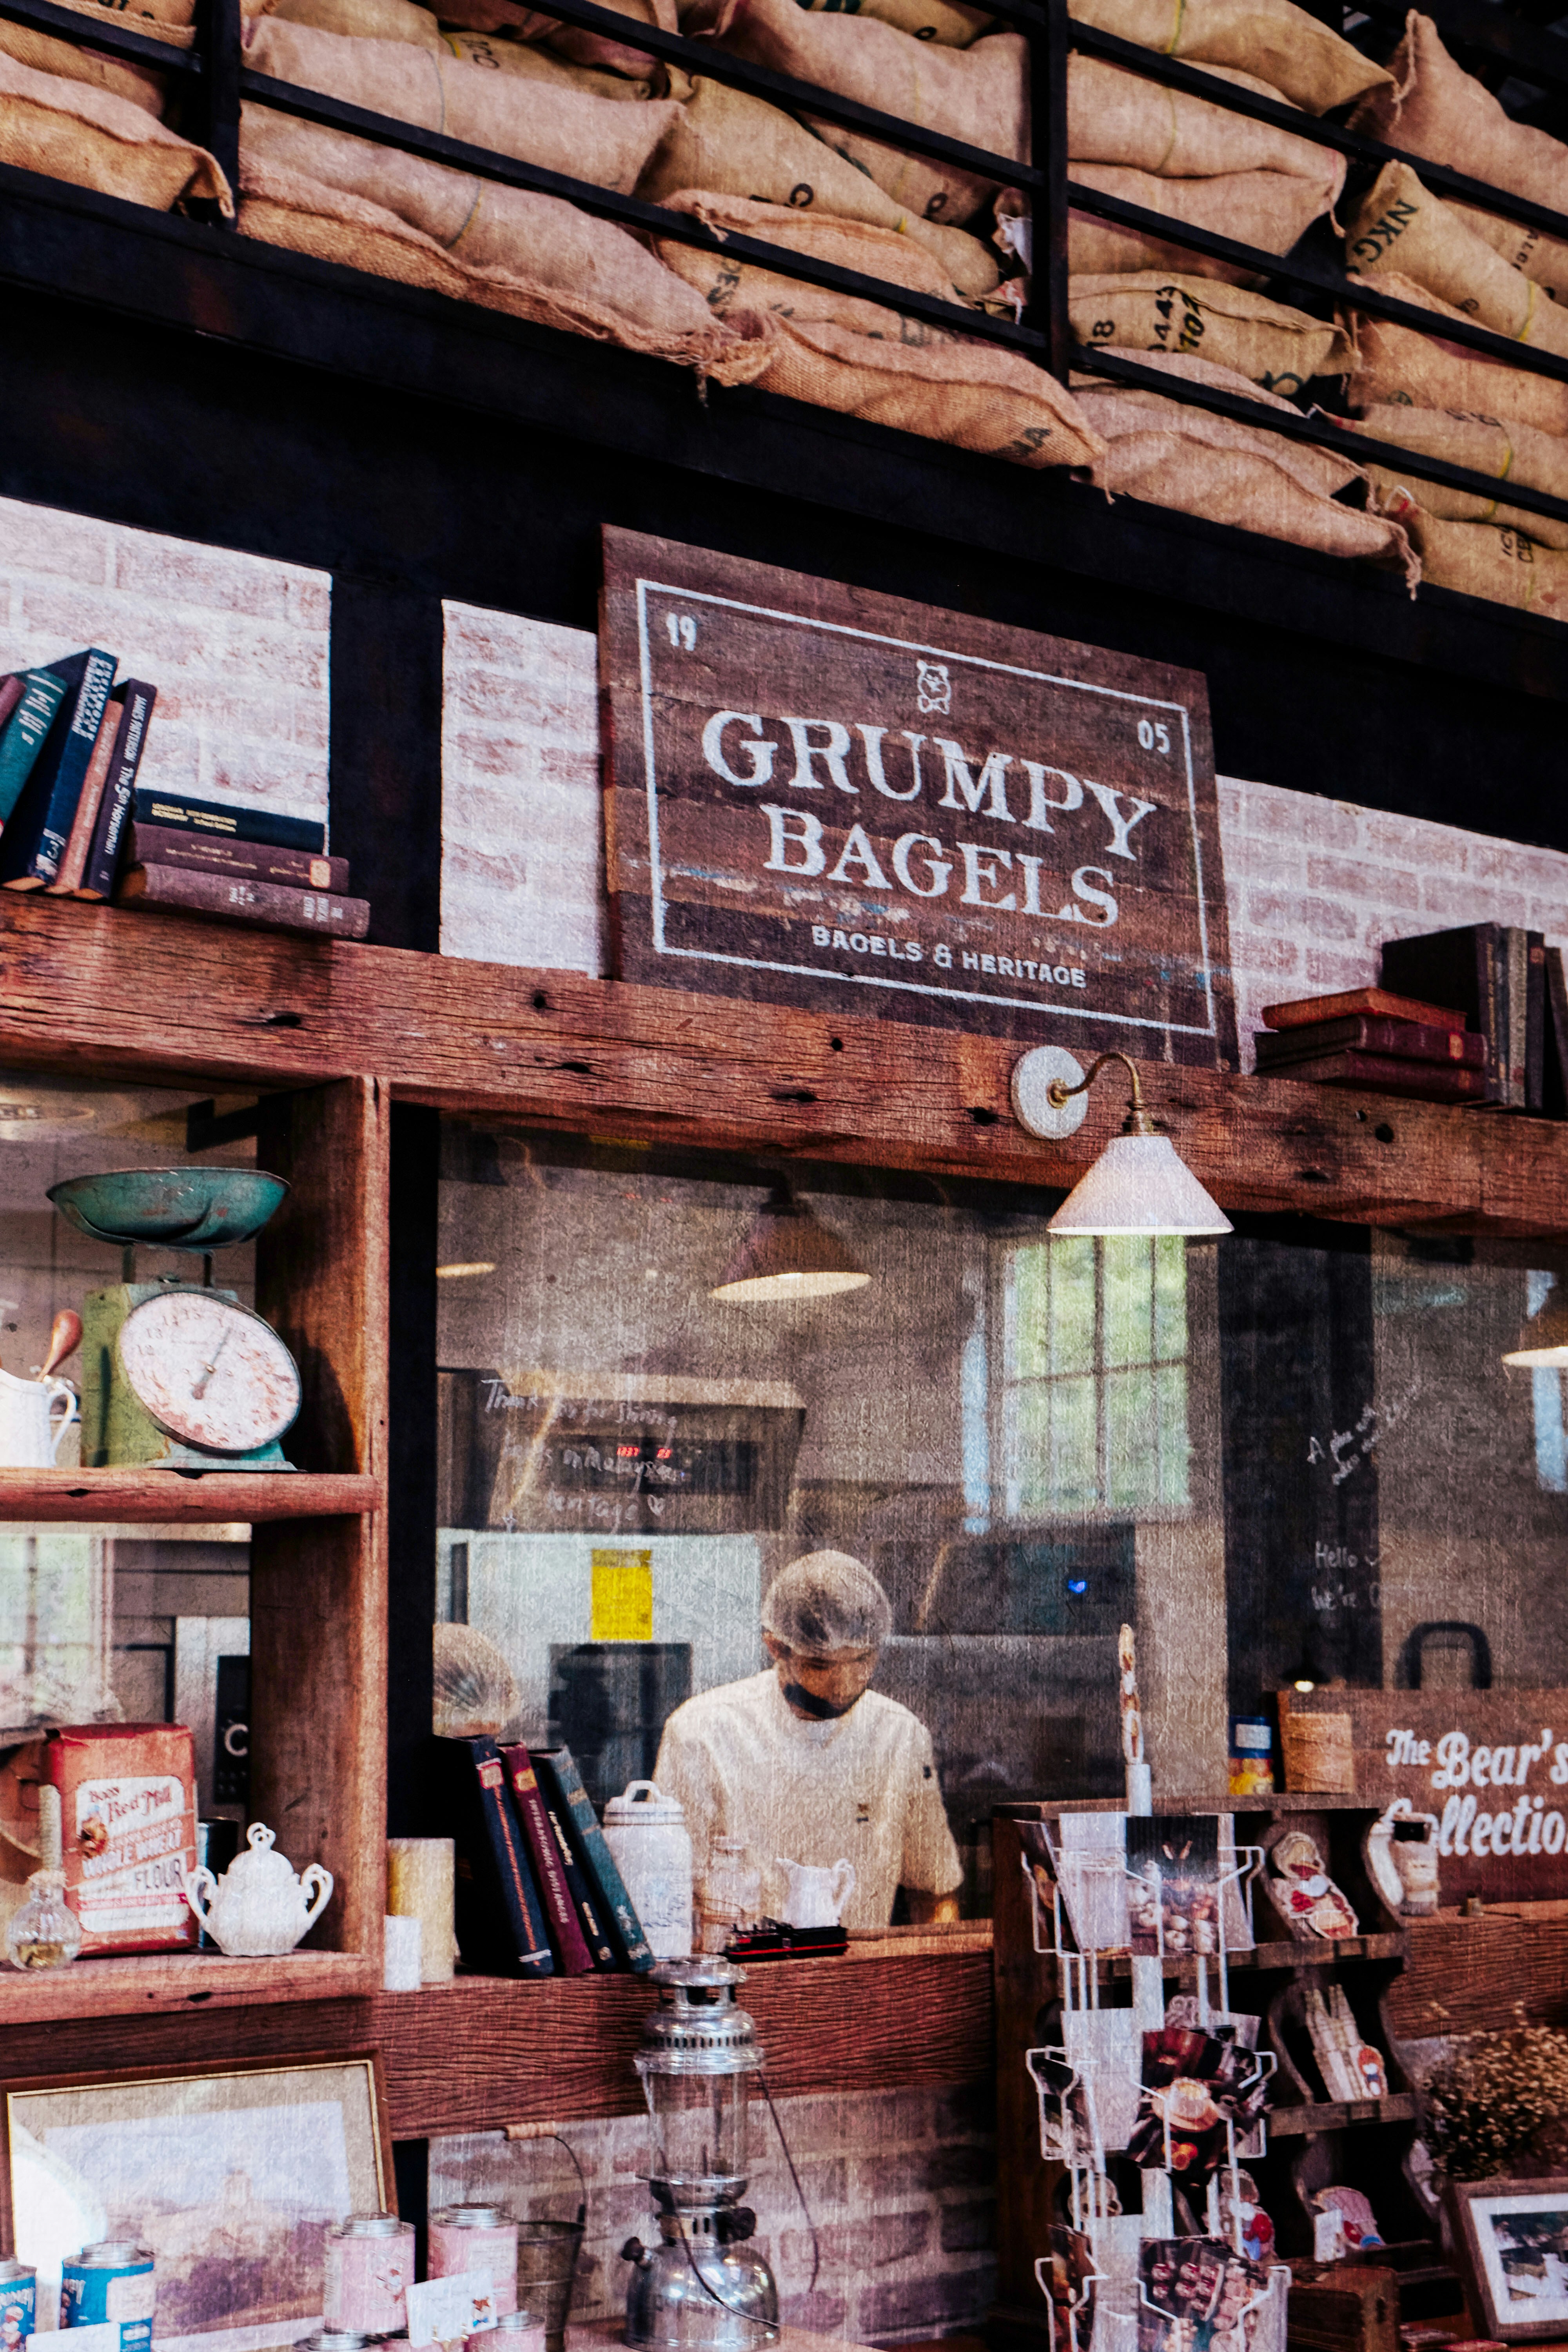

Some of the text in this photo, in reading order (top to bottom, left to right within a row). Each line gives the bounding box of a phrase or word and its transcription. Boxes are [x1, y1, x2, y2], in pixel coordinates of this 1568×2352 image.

[1353, 198, 1418, 263] NKG
[666, 611, 697, 652] 19
[132, 693, 148, 722] JAMES
[123, 718, 143, 763] PATTERSON
[1137, 720, 1171, 754] 05
[118, 766, 134, 786] The
[701, 710, 1157, 861] GRUMPY
[104, 803, 126, 856] Horseman
[759, 804, 1120, 928] BAGELS
[811, 925, 1087, 989] BAGELS & HERITAGE
[1315, 1540, 1359, 1568] Hello
[1386, 1728, 1568, 1789] The Bear's
[1379, 1797, 1568, 1857] llectio
[82, 1845, 134, 1878] WHOLE
[135, 1858, 184, 1889] FLOUR
